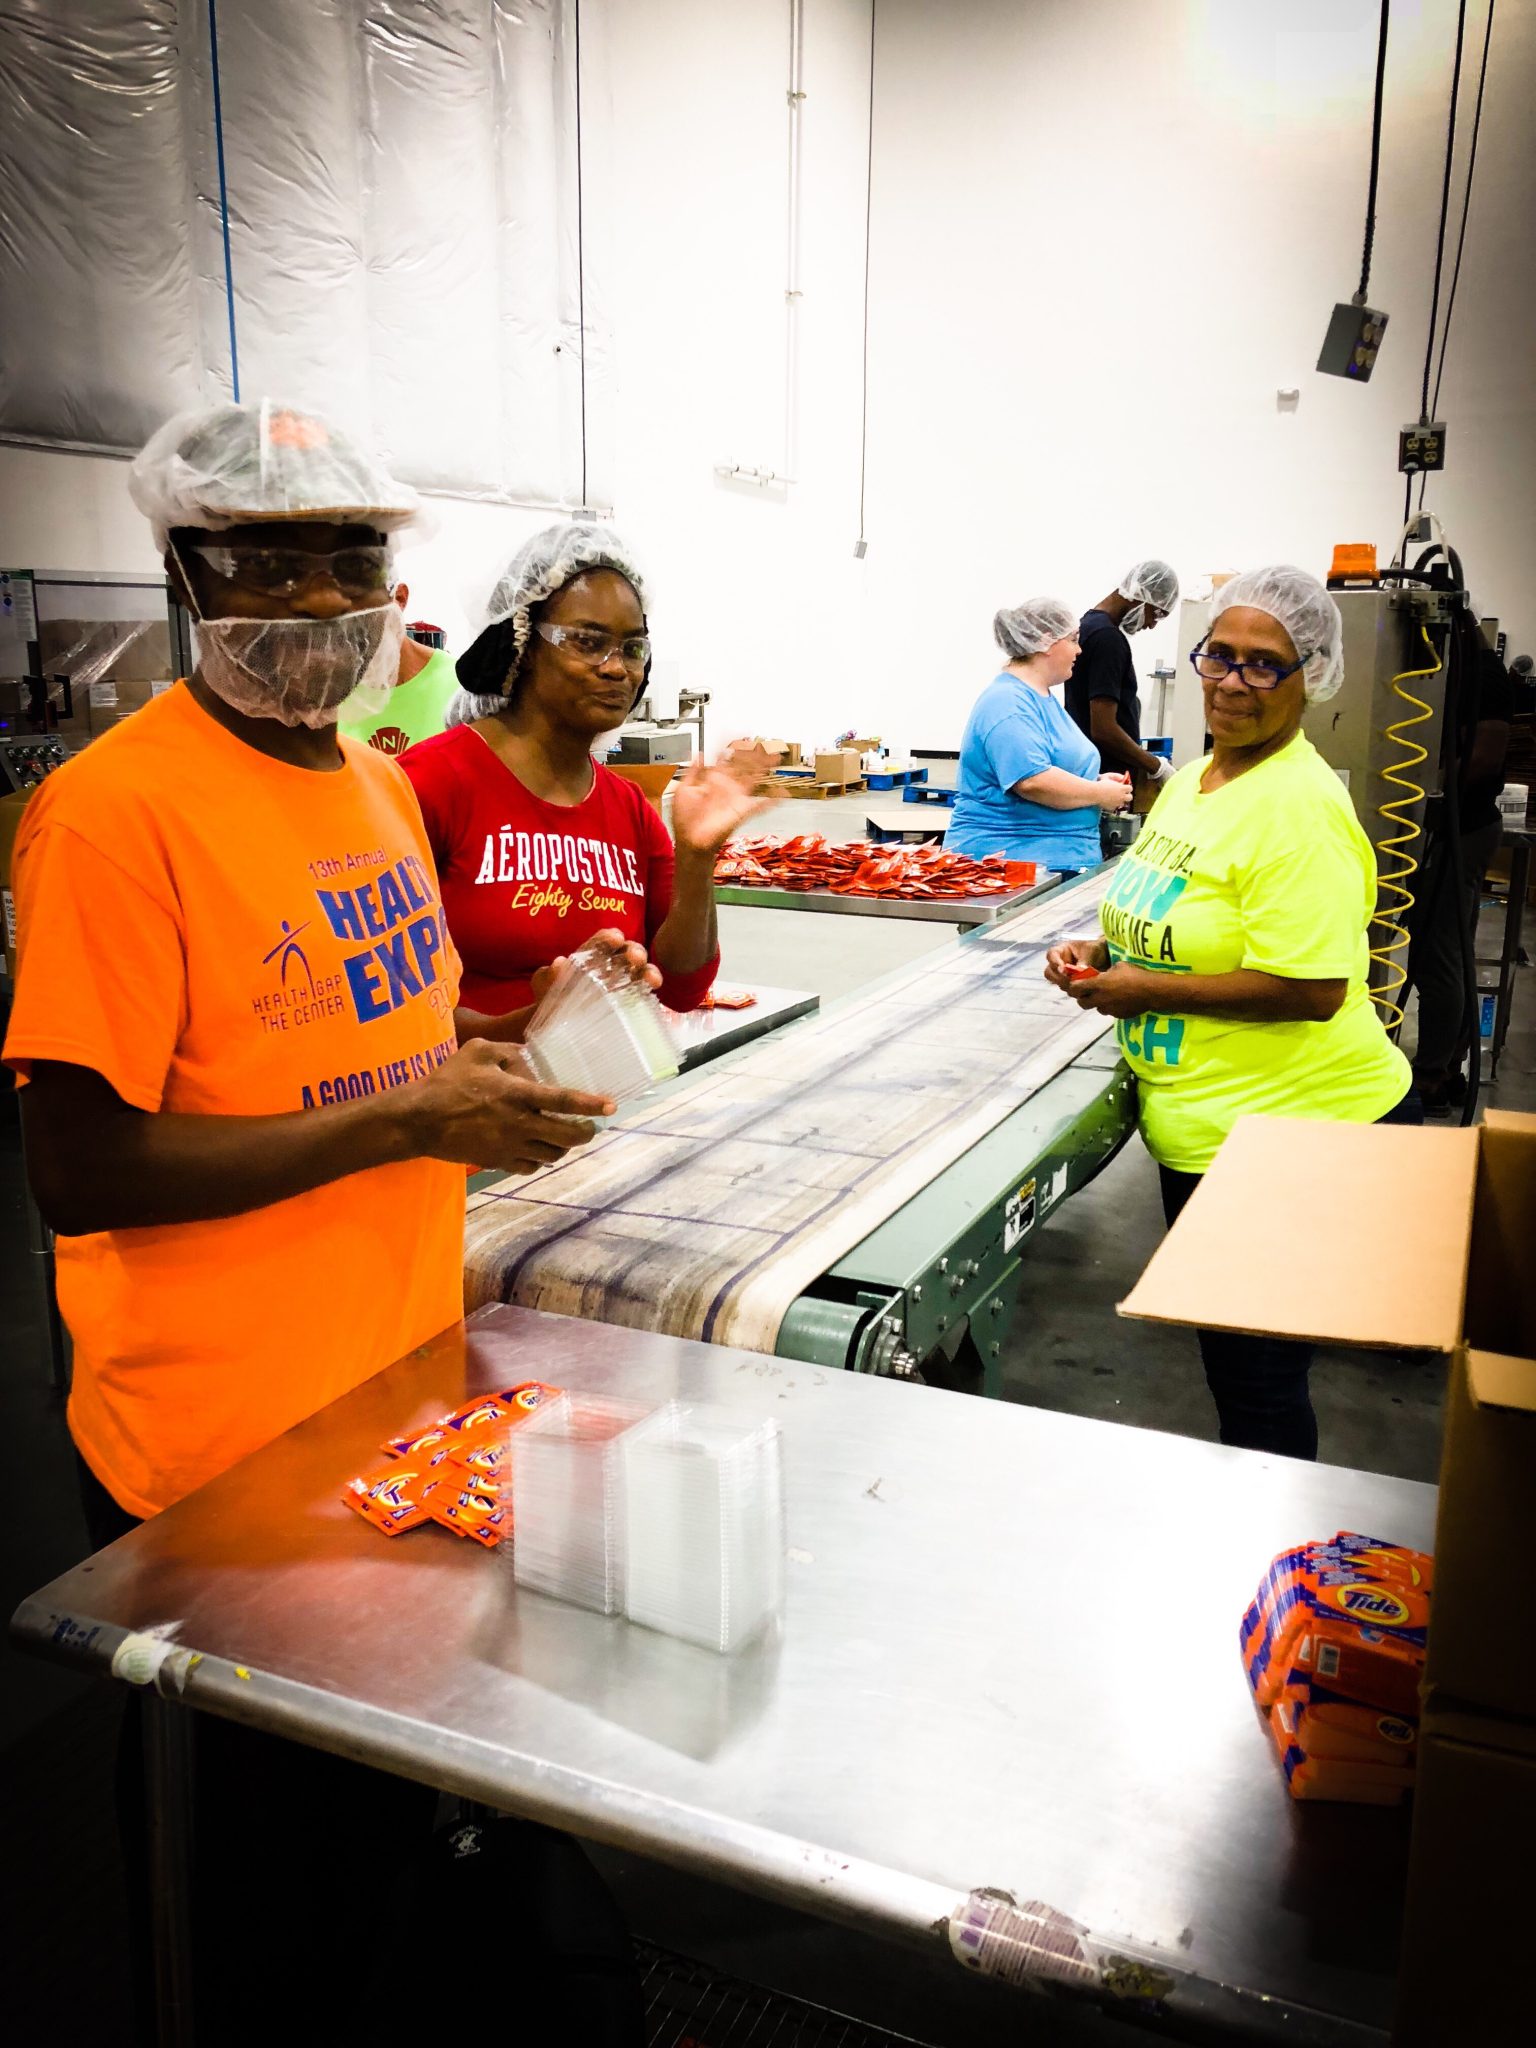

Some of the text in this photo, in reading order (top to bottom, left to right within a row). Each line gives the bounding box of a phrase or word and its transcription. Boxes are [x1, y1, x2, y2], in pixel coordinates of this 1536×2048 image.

[382, 735, 396, 749] N
[308, 846, 389, 881] 13th Annual
[474, 823, 645, 897] AÉROPOSTALE
[315, 855, 434, 941] HEALT
[511, 882, 627, 918] Eighty Seven
[1159, 925, 1177, 963] A
[252, 974, 343, 1014] HEALTH GAP
[260, 995, 346, 1034] THE CENTER
[301, 1085, 315, 1110] A
[318, 1070, 377, 1107] GOOD
[377, 1058, 411, 1092] LIFE
[1344, 1590, 1402, 1617] Tide
